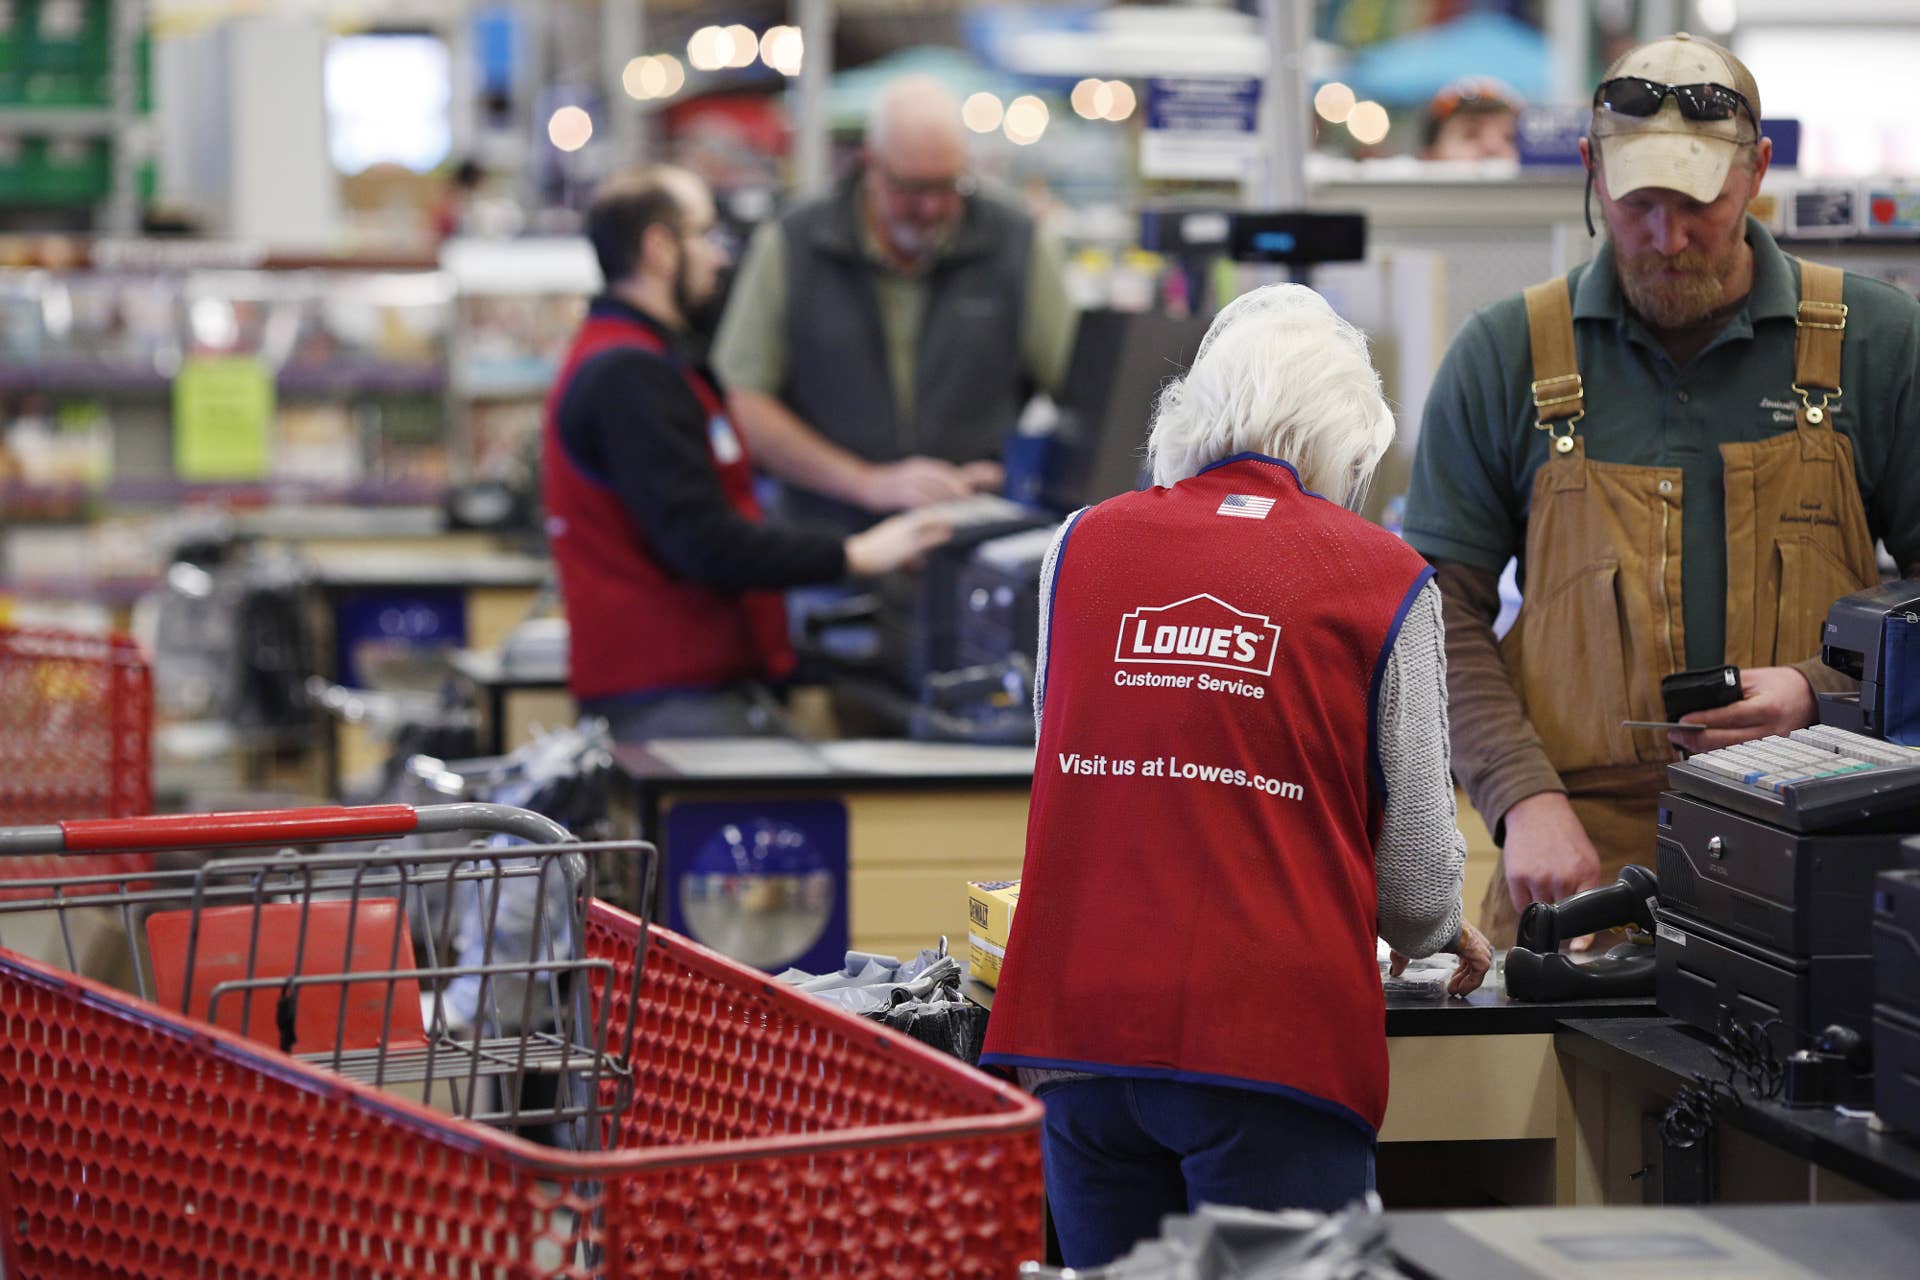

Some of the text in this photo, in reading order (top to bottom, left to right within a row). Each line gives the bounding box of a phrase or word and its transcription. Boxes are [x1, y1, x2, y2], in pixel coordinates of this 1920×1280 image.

[1133, 619, 1260, 663] LOWE'S
[1114, 670, 1265, 700] Customer Service
[1058, 752, 1305, 801] Visit us at Lowes.com
